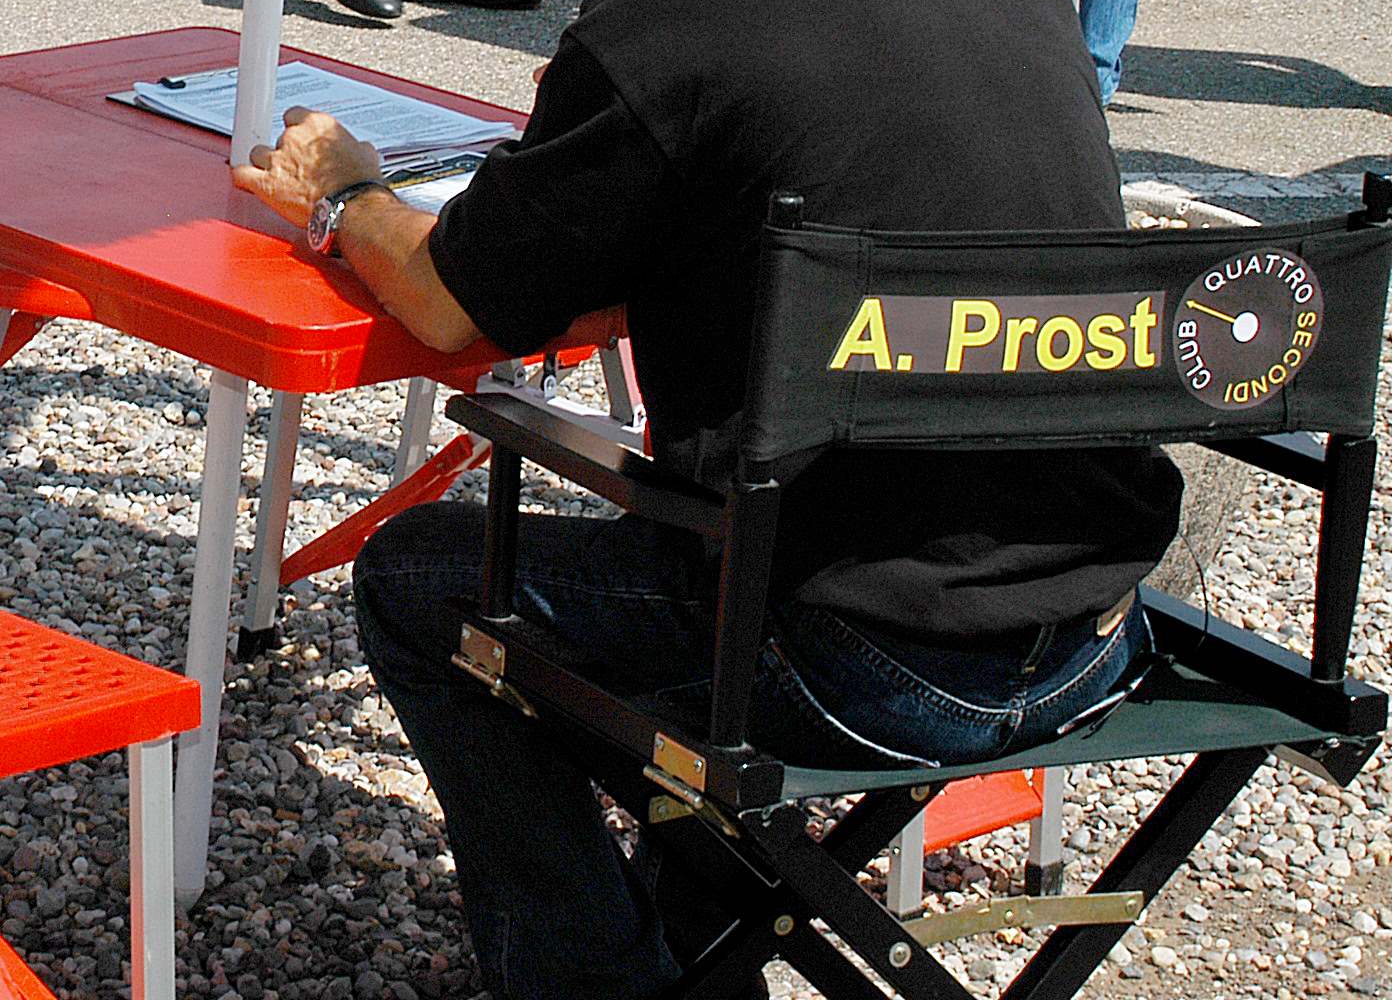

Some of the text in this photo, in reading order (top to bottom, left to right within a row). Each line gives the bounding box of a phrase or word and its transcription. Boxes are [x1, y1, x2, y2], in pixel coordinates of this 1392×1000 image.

[829, 296, 1157, 372] A. Prost
[1178, 254, 1317, 403] CLUB QUATTRO SECONDI
